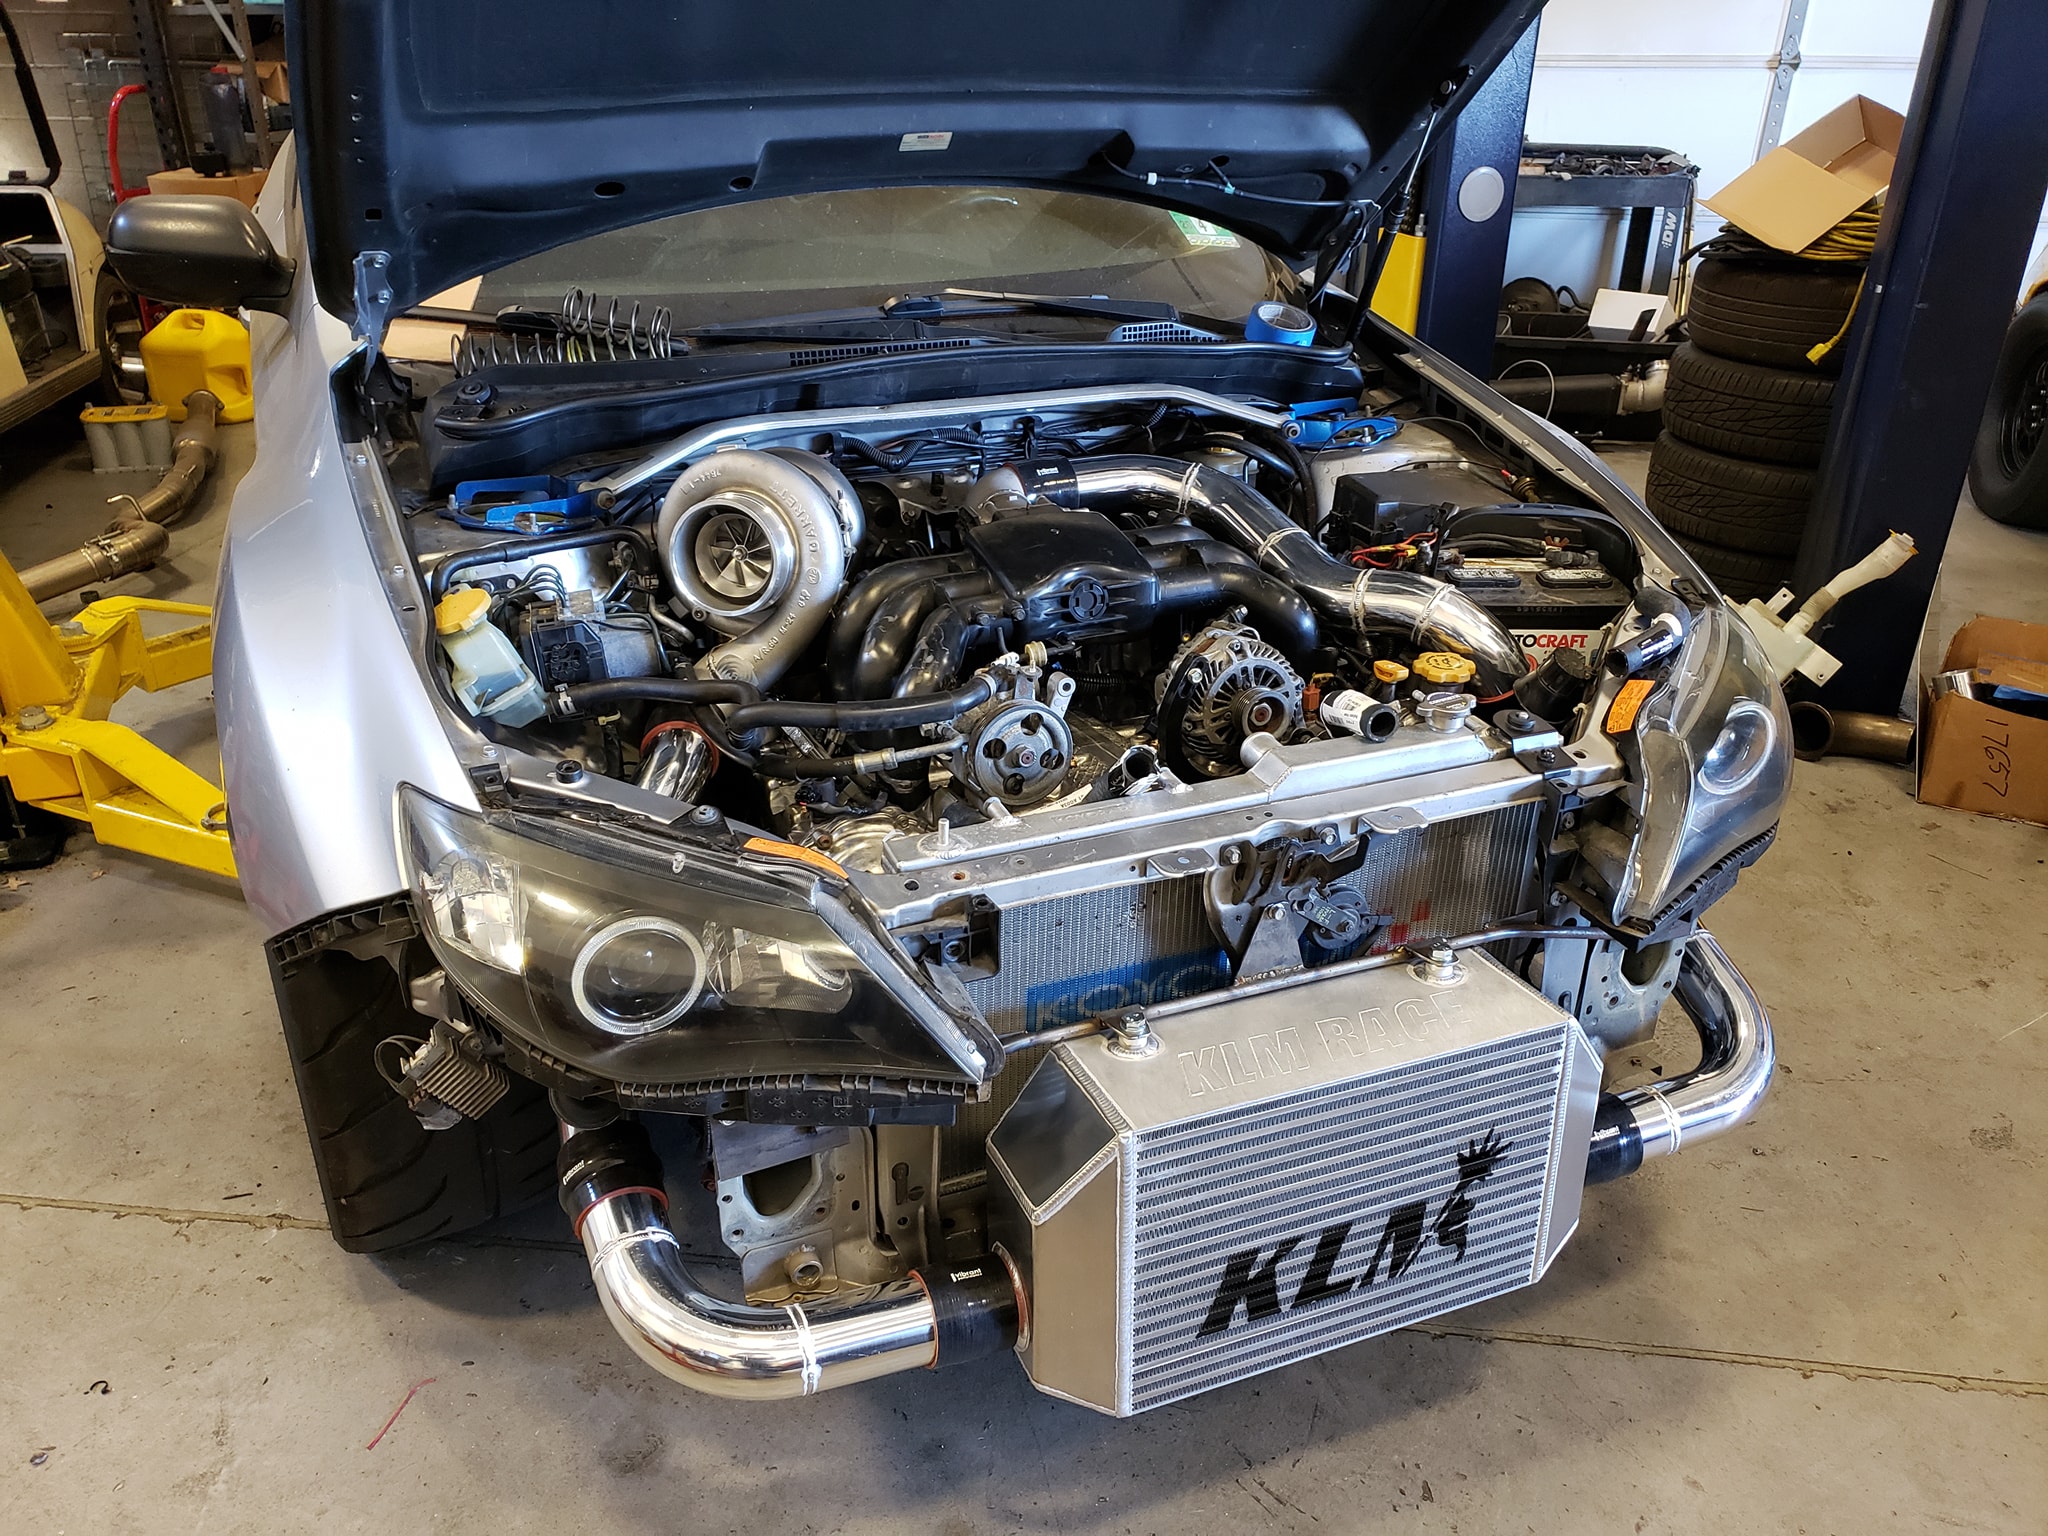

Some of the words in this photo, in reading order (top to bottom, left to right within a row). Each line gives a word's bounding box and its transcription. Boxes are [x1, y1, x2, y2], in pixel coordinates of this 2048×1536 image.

[1662, 211, 1677, 244] DW
[769, 480, 820, 553] GARRETT
[1511, 634, 1588, 648] TOCRAFT
[1981, 718, 2011, 797] 17657
[1177, 1026, 1311, 1098] KLM
[1314, 990, 1473, 1063] RACE
[1196, 1190, 1478, 1338] KLM
